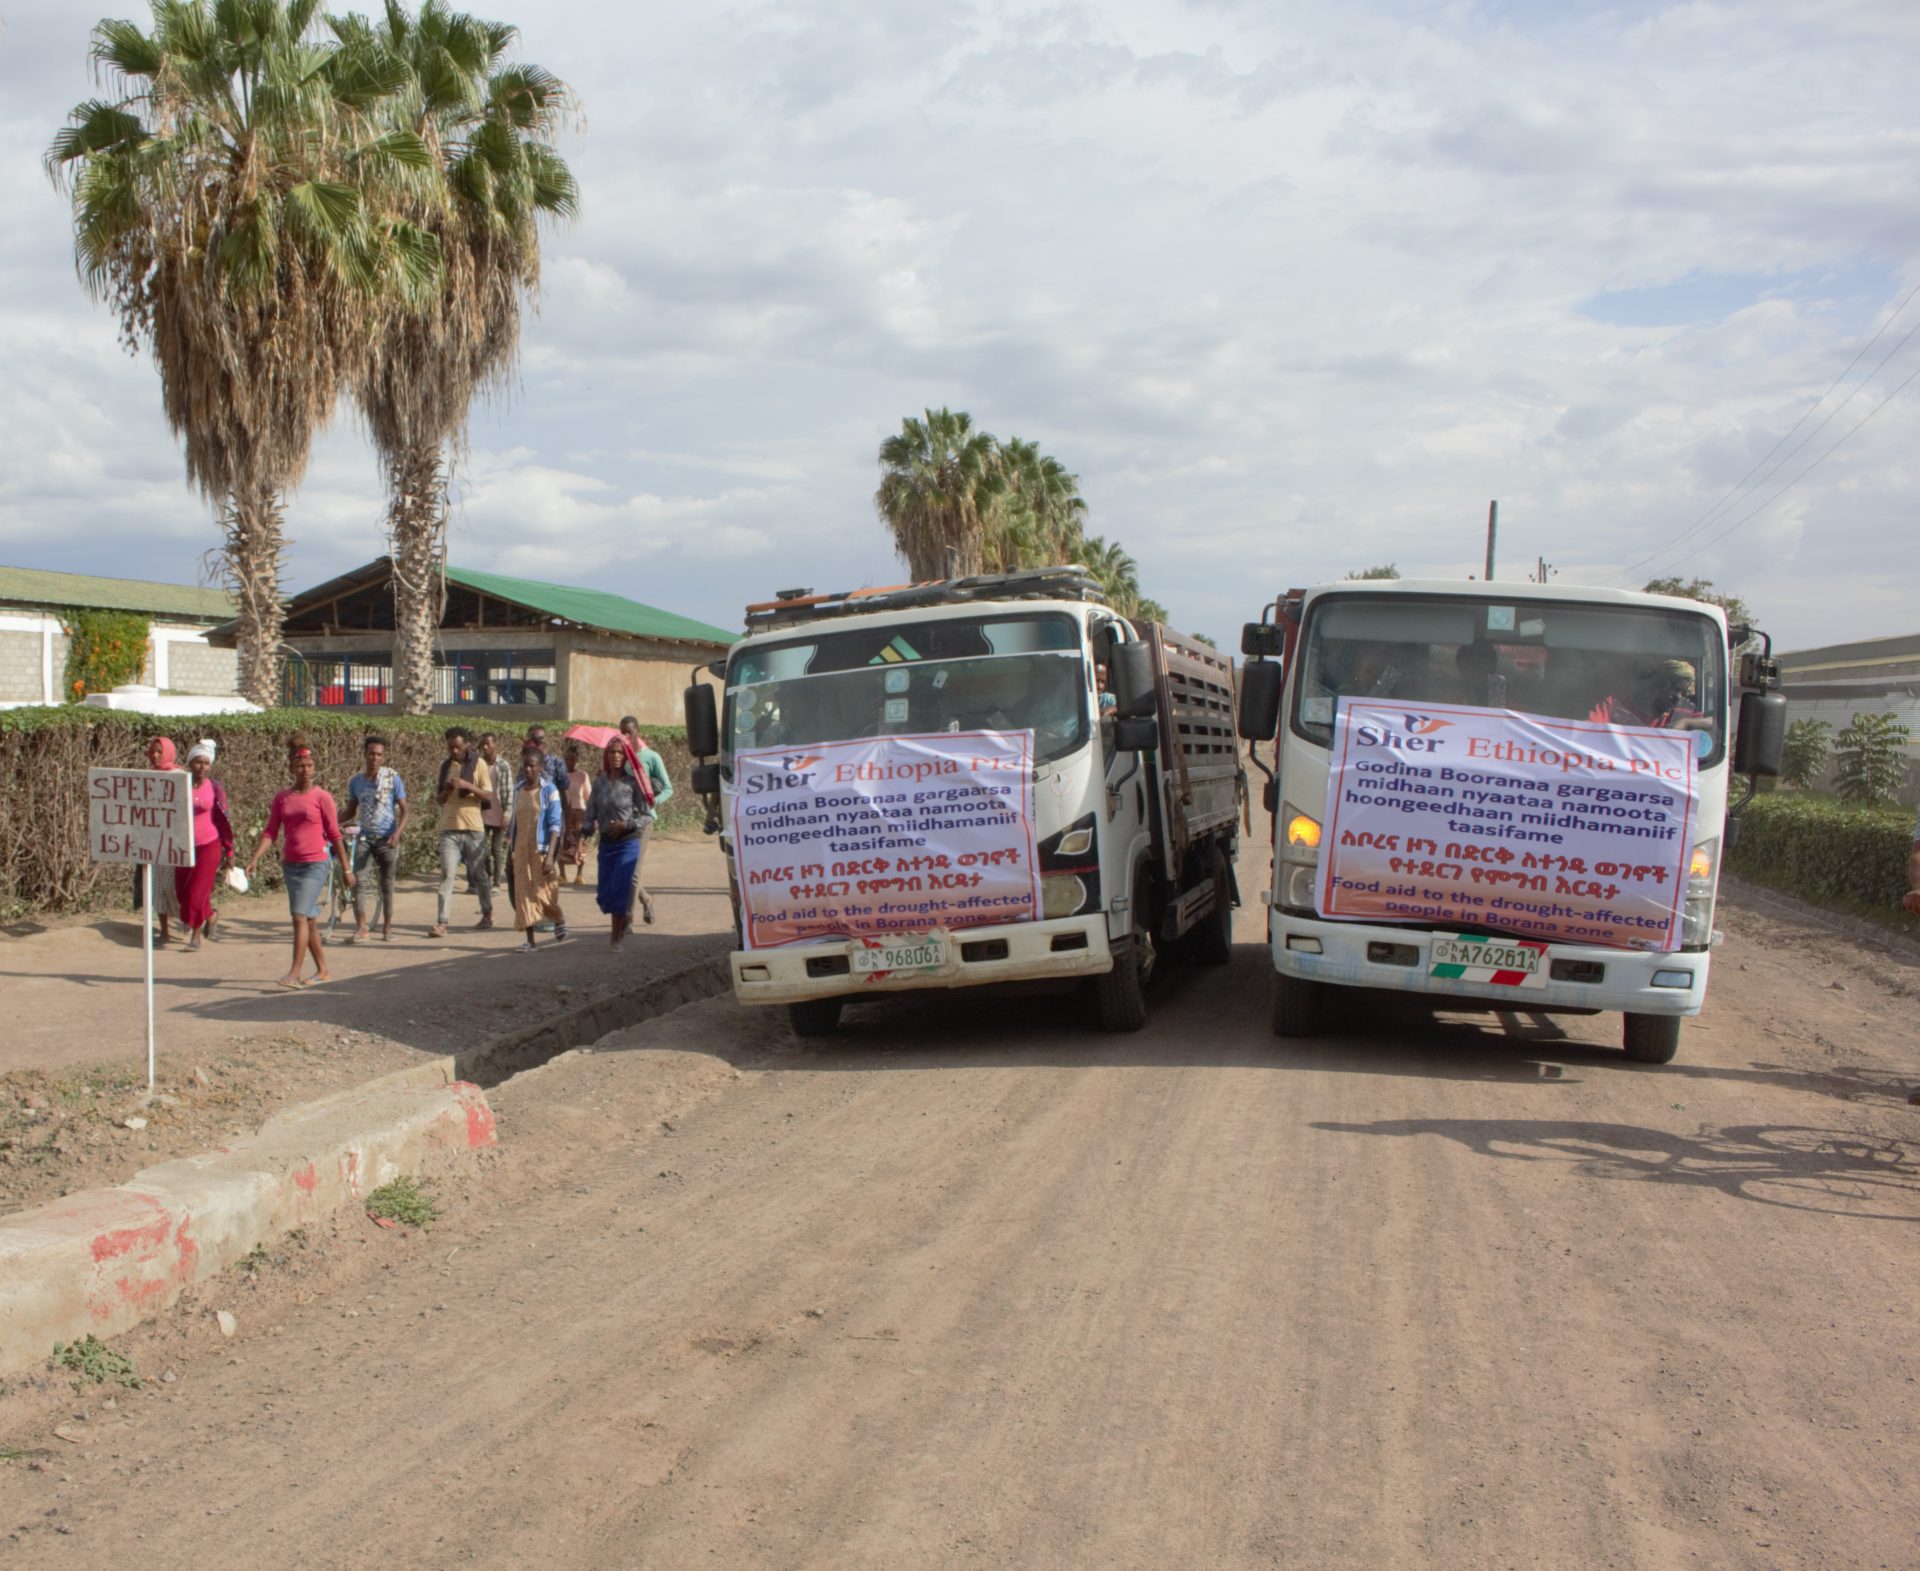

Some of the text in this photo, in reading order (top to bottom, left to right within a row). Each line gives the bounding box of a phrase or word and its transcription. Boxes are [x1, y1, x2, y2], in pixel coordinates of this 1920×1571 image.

[1356, 726, 1682, 780] Sher Ethiopia Plc
[91, 776, 175, 803] SPEED
[746, 773, 816, 794] Sher
[835, 755, 960, 783] Ethiopia
[1355, 760, 1674, 806] Godina Booranaa gargaarsa
[745, 785, 1012, 816] Godina Booranaa gargaarsa
[751, 799, 1006, 830] midhaan nyaataa namoota
[1345, 790, 1677, 840] hoongeedhaan miidhamaniif
[1358, 777, 1666, 822] midhaan nyaataa namoota
[103, 804, 176, 829] LIMIT
[744, 812, 1018, 847] hoongeedhaan miidhamaniif
[1448, 820, 1563, 844] taasifame
[830, 836, 926, 853] taasifame
[751, 892, 1032, 924] Food aid to the drought-affected
[1332, 876, 1669, 930] Food aid to the drought-affected
[855, 919, 871, 930] in
[876, 916, 937, 929] Borana
[1386, 902, 1613, 938] people in Borana zone
